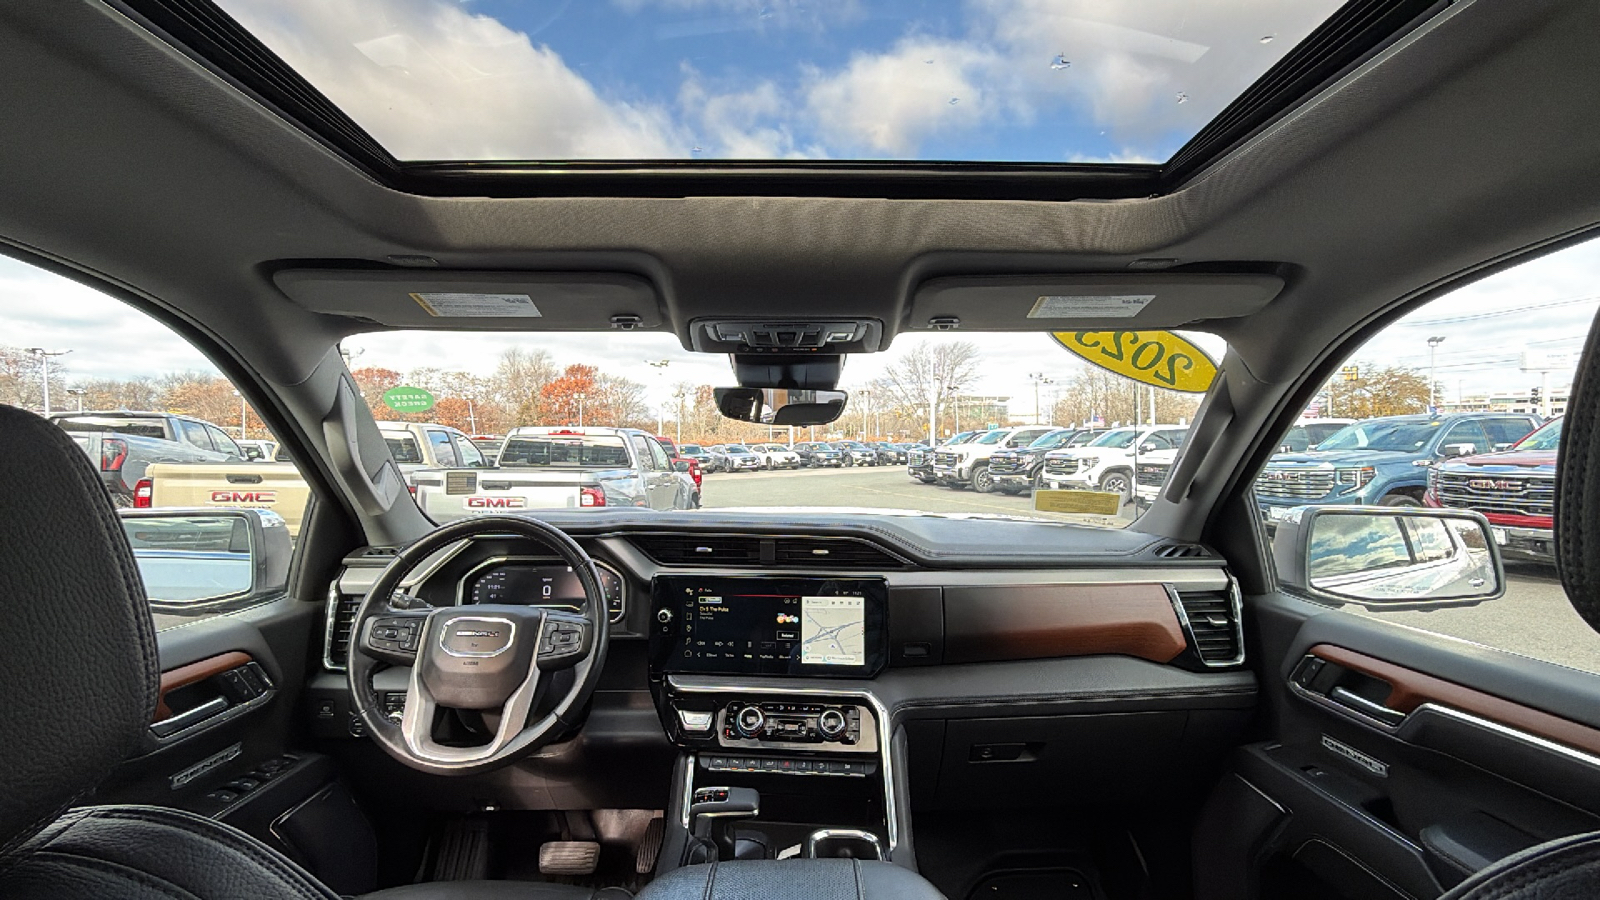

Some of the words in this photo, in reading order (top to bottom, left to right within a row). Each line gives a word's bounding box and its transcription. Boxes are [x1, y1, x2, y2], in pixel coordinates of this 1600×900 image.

[1469, 479, 1523, 491] GMC
[211, 491, 276, 503] GMC
[467, 497, 524, 508] GMC
